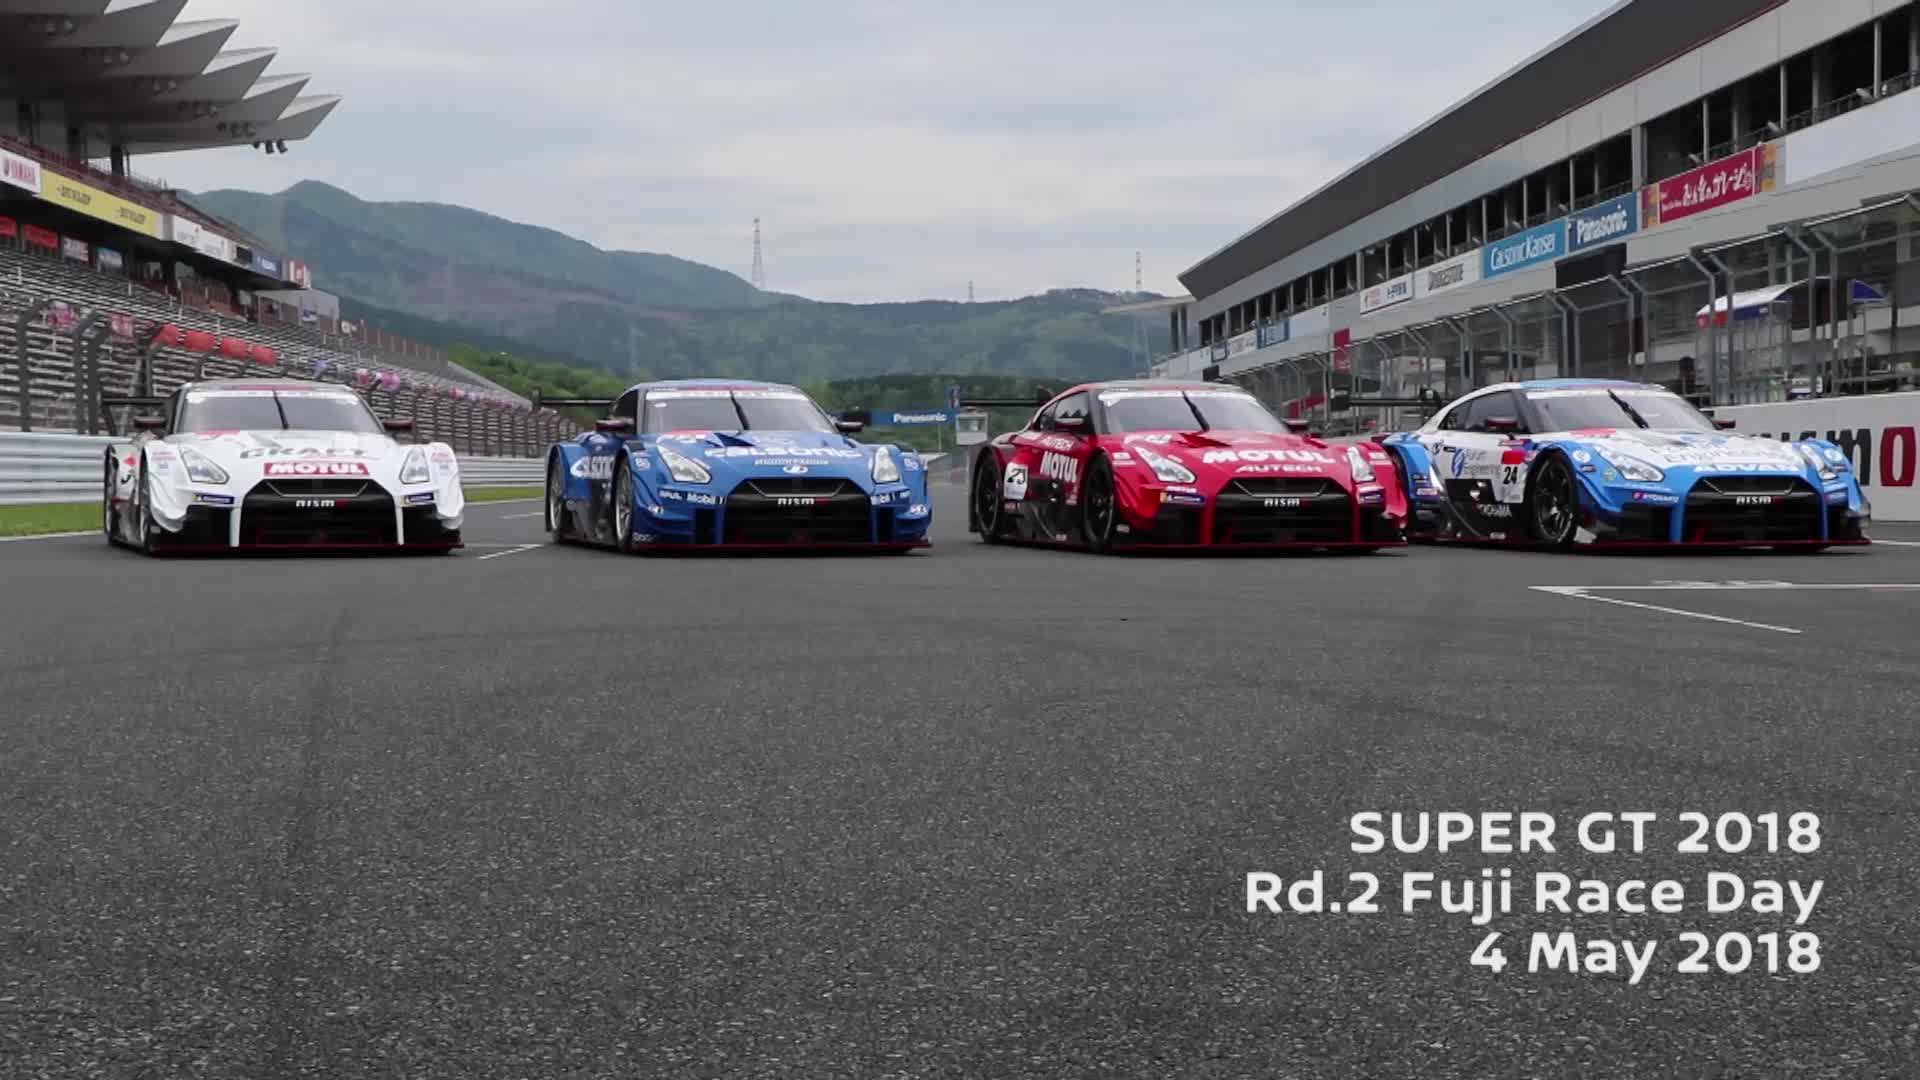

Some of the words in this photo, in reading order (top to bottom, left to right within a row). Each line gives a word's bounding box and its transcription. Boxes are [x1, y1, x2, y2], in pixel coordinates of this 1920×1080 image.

[1576, 203, 1628, 245] Panasonic
[892, 411, 948, 424] Panasonic
[1203, 449, 1337, 464] MOTUL
[267, 462, 368, 475] MOTUL
[1040, 450, 1079, 483] MOTUL
[1235, 464, 1324, 473] AUTECH
[1503, 466, 1519, 485] 24
